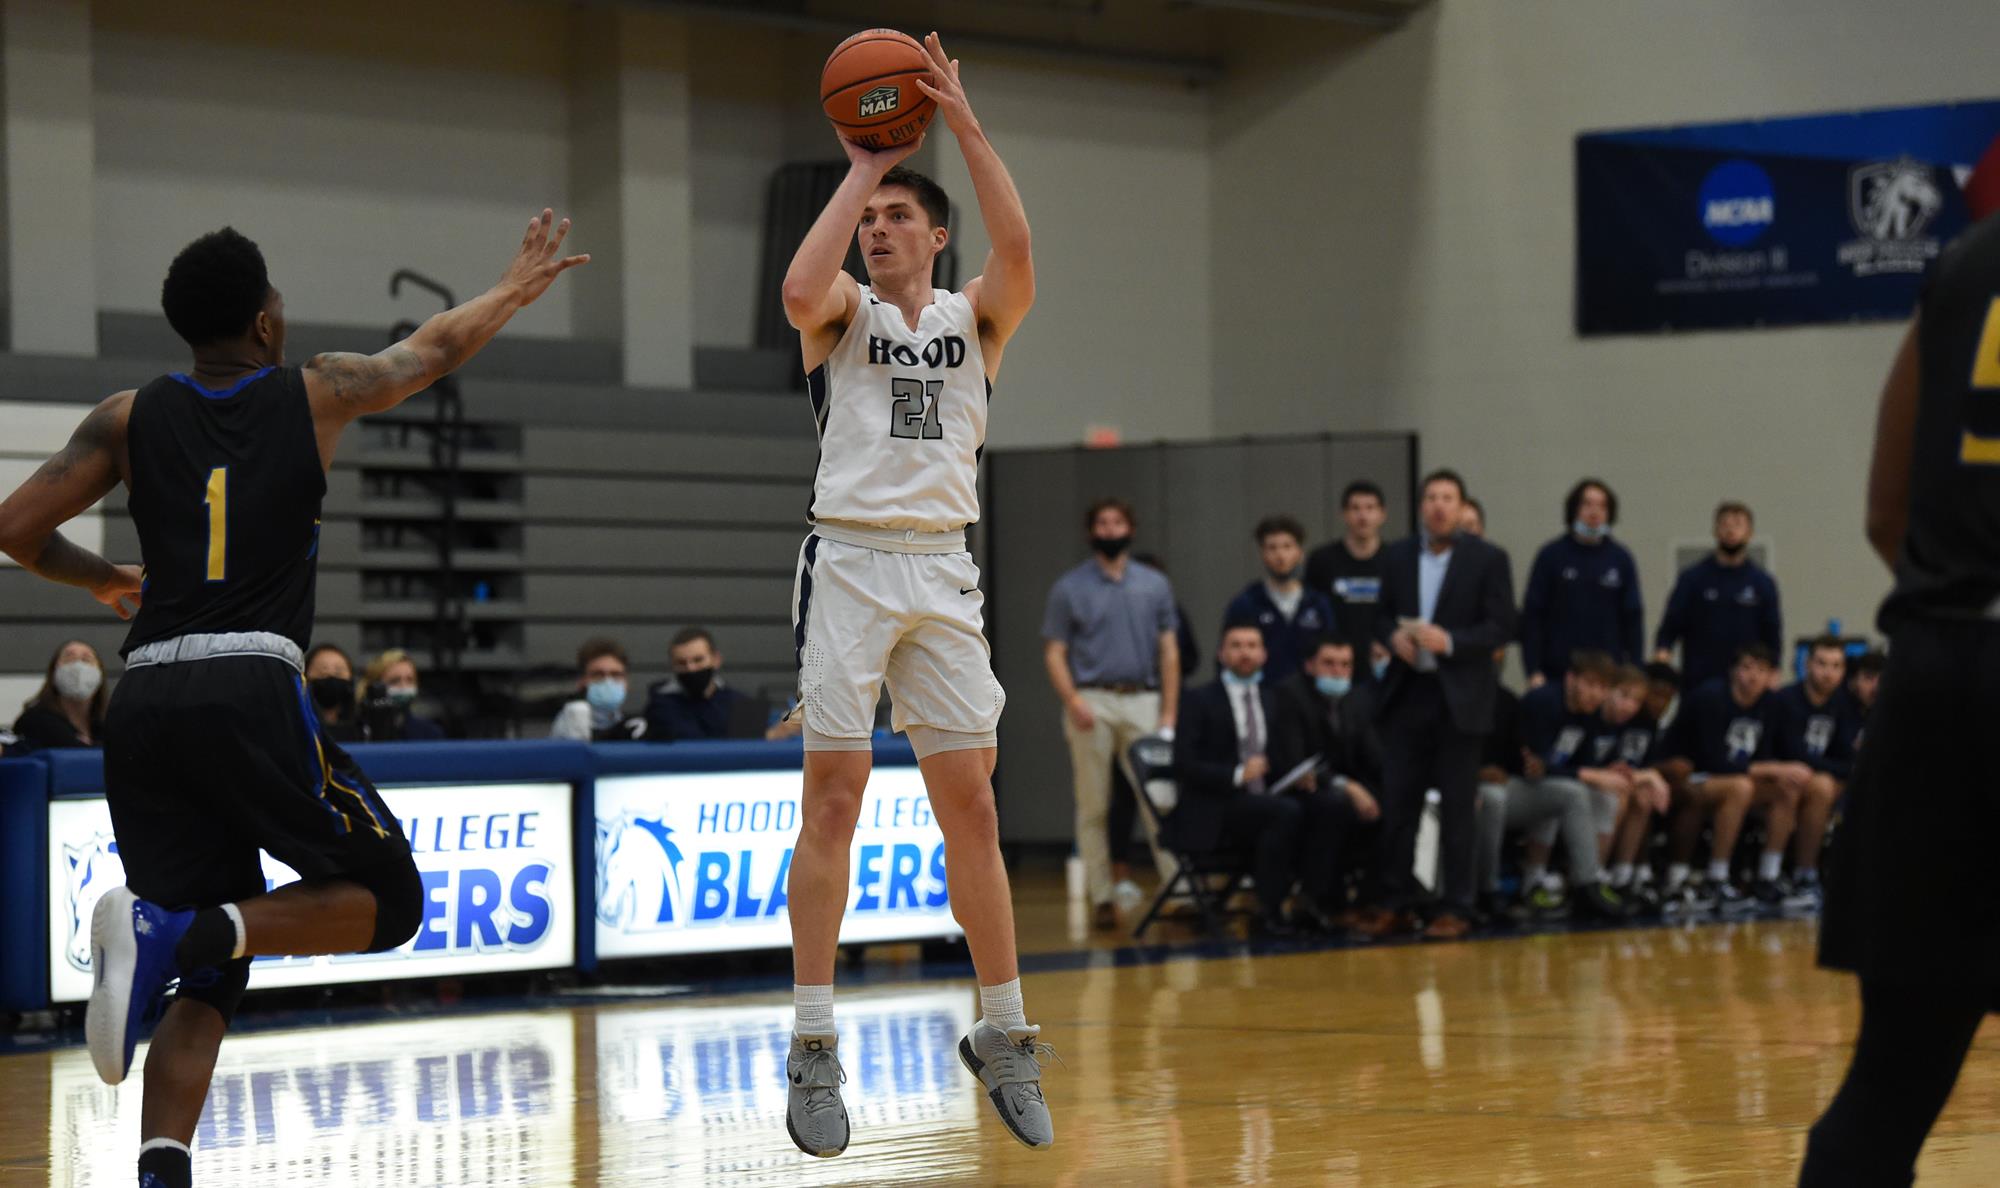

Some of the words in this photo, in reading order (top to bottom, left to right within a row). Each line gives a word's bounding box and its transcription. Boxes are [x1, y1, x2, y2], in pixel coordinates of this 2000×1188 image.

[860, 96, 897, 116] MAC
[887, 113, 926, 143] ROCK
[1703, 196, 1774, 227] NCAA
[868, 334, 966, 368] HOOD
[890, 377, 944, 440] 21
[203, 465, 228, 582] 1
[398, 811, 539, 853] LLEGE
[697, 799, 795, 834] HOOD
[692, 841, 948, 921] BLAERS
